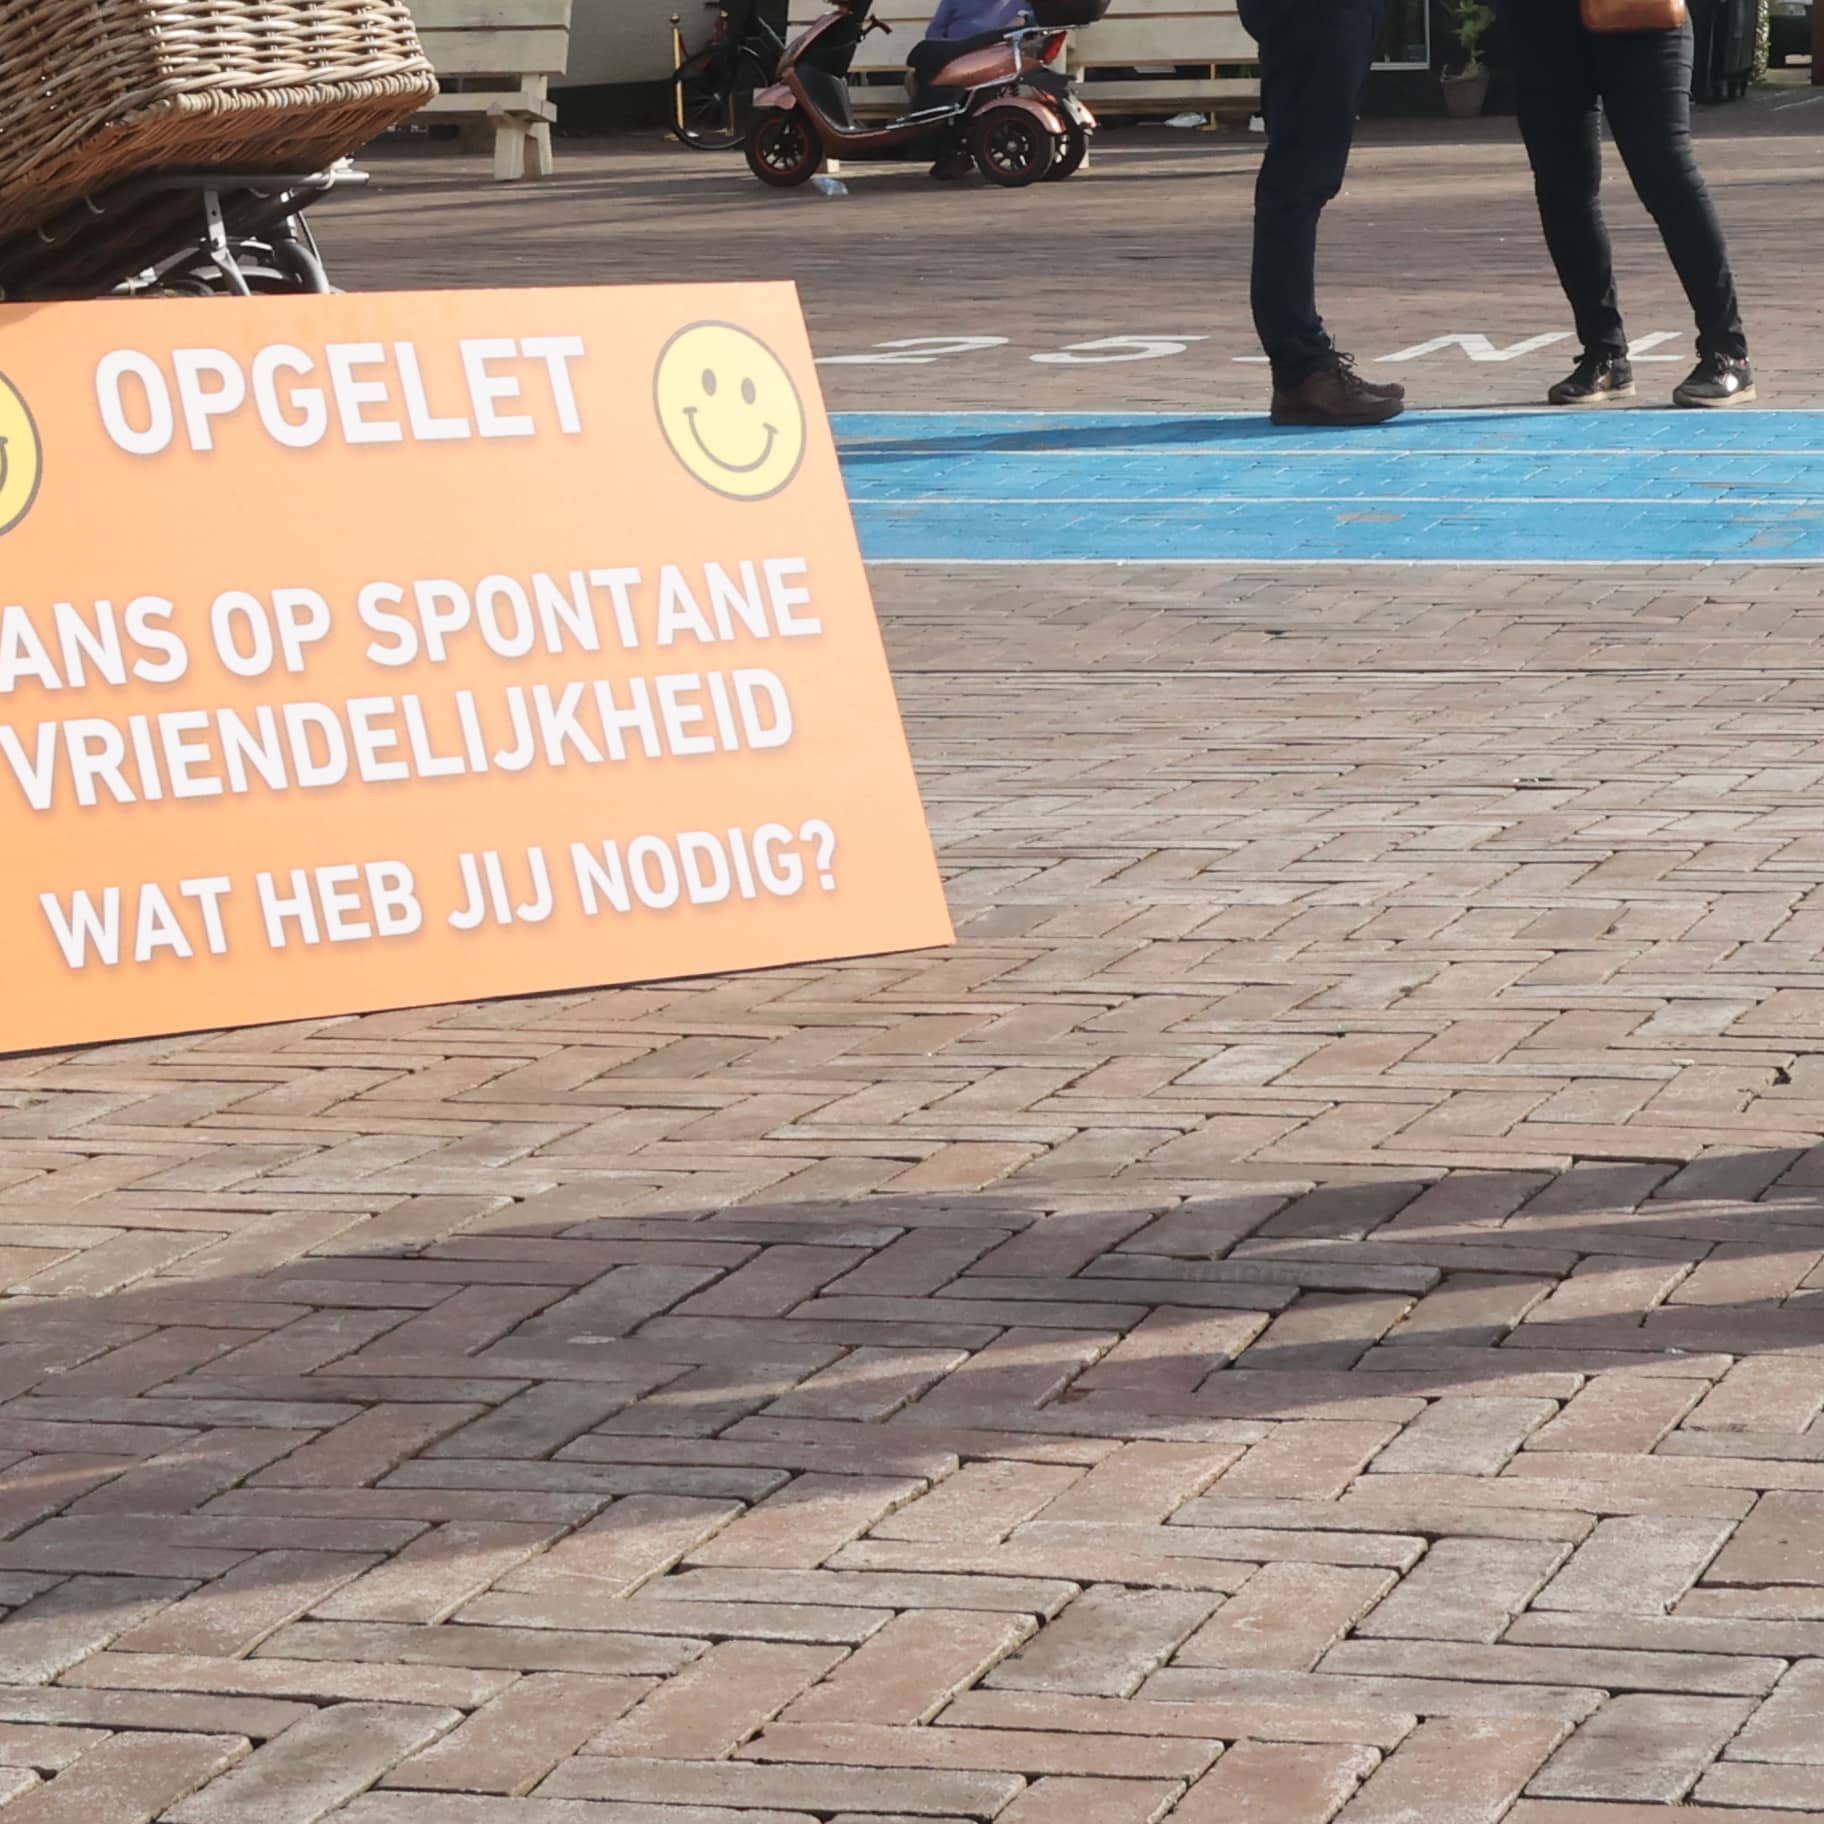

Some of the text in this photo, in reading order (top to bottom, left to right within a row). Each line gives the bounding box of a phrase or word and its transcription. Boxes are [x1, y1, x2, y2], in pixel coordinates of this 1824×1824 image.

[96, 336, 584, 453] OPGELET
[212, 589, 330, 675] OP
[358, 557, 822, 665] SPONTANE
[40, 819, 840, 967] WAT HEB JIJ NODIG?
